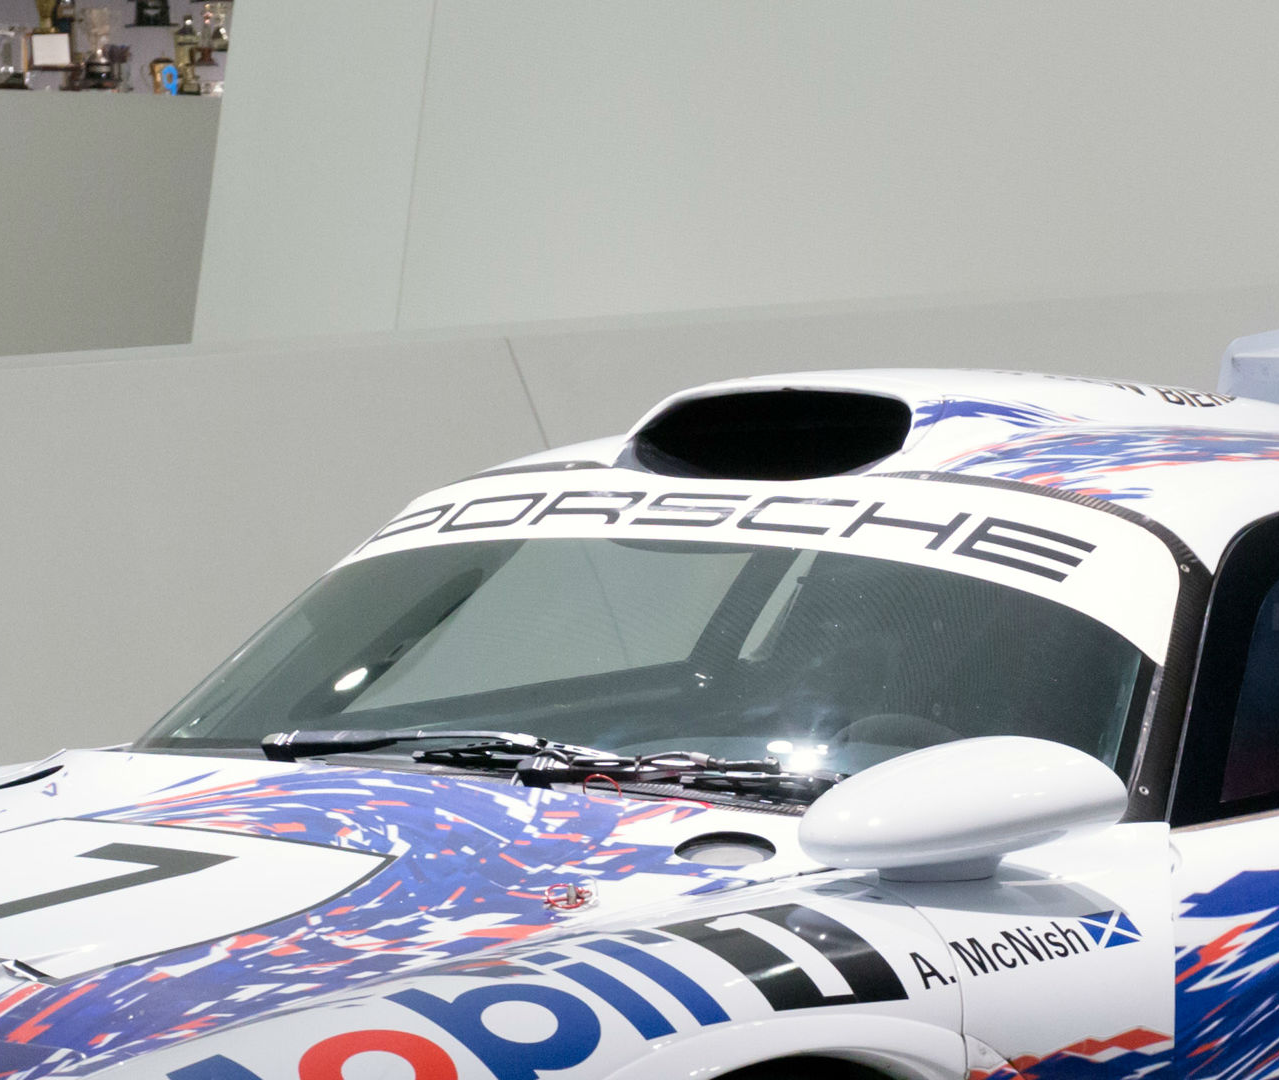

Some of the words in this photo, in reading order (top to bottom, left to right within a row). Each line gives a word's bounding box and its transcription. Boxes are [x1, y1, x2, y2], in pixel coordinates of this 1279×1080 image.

[356, 490, 1097, 583] PORSCHE
[909, 951, 955, 990] A.
[948, 924, 1091, 979] McNish
